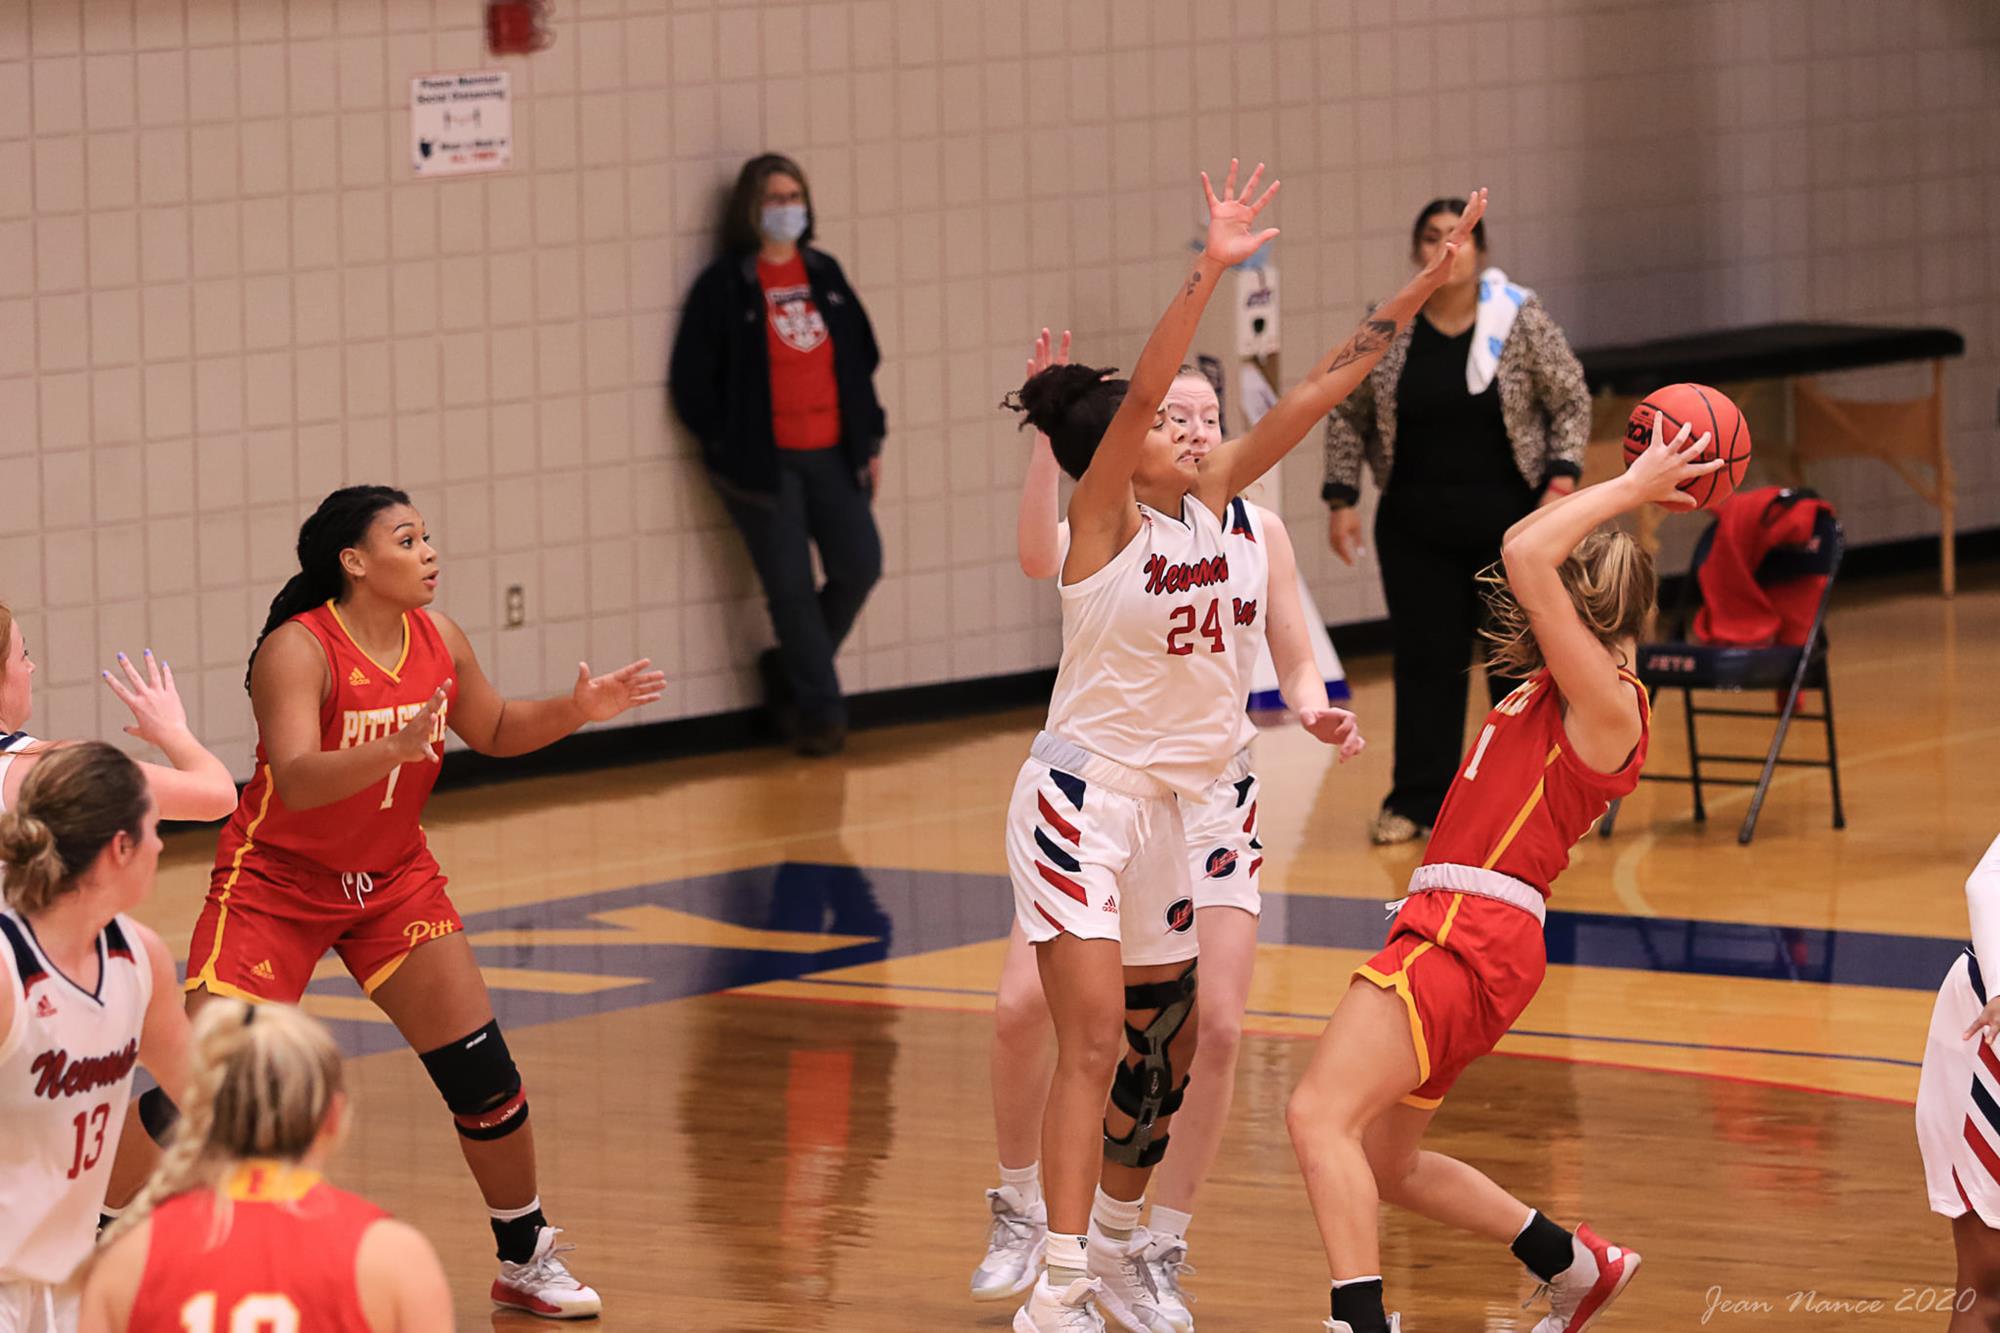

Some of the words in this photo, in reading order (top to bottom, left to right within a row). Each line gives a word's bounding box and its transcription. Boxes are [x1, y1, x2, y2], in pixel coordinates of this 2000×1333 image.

[1167, 598, 1225, 656] 24
[340, 707, 395, 749] PITT
[403, 919, 454, 947] Pitt
[67, 1102, 111, 1180] 13
